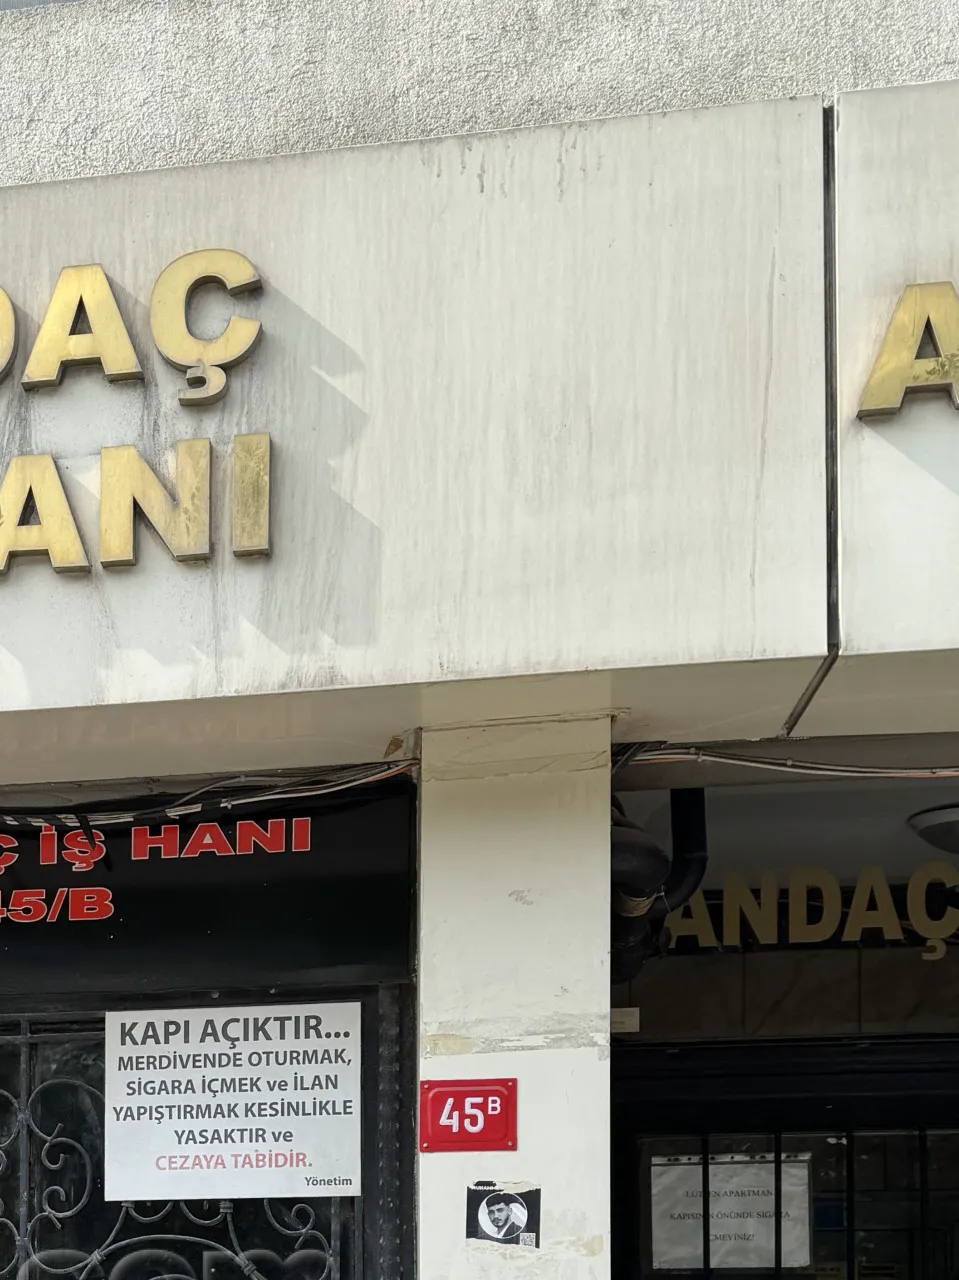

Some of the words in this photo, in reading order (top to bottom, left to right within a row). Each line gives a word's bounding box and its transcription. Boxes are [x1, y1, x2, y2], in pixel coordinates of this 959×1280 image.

[39, 825, 106, 872] İŞ
[131, 817, 311, 860] HANI
[664, 861, 959, 961] ANDAÇ
[120, 1020, 190, 1046] KAPI
[199, 1015, 351, 1049] AÇIKTIR...
[117, 1051, 242, 1071] MERDİVENDE
[248, 1048, 352, 1067] OTURMAK,
[126, 1077, 196, 1096] SİGARA
[201, 1075, 262, 1098] İÇMEK
[266, 1080, 288, 1092] ve
[293, 1072, 338, 1091] İLAN
[113, 1103, 239, 1124] YAPIŞTIRMAK
[244, 1097, 353, 1118] KESİNLİKLE
[174, 1128, 267, 1145] YASAKTIR
[271, 1130, 293, 1142] ve
[155, 1155, 226, 1171] CEZAYA
[230, 1149, 313, 1169] TABİDİR.
[304, 1176, 352, 1187] Yönetim
